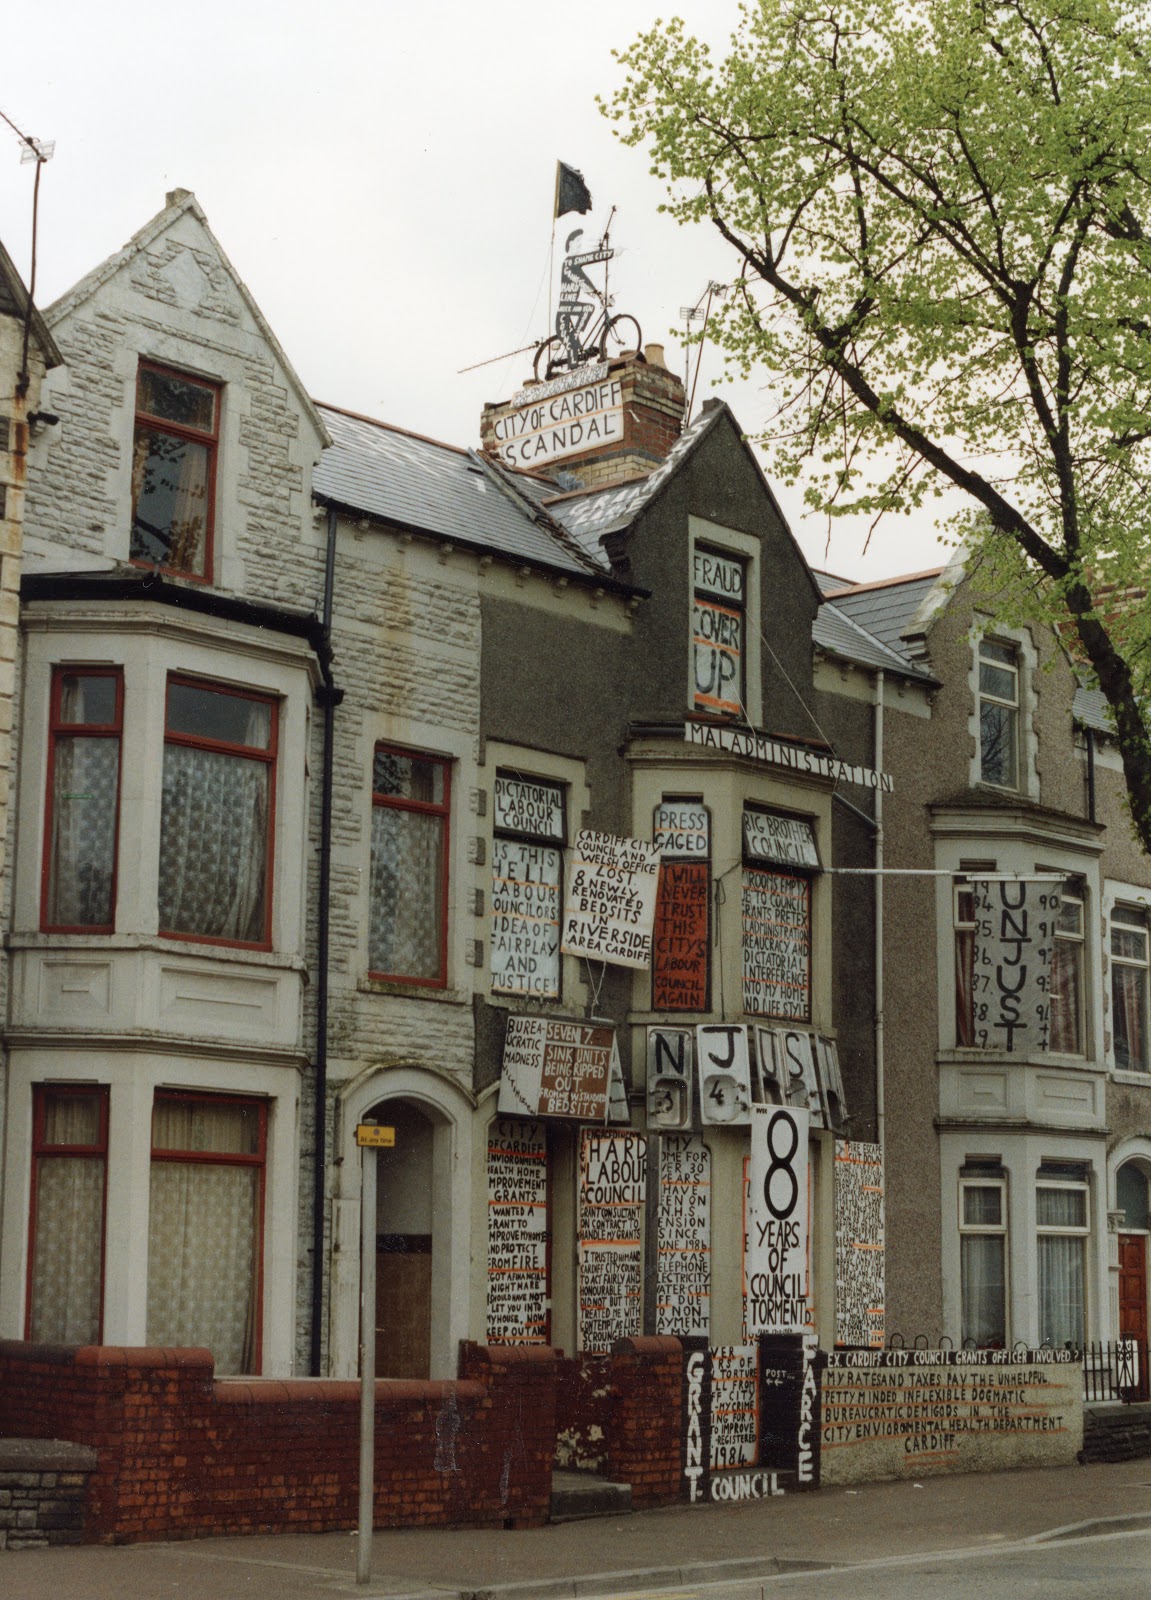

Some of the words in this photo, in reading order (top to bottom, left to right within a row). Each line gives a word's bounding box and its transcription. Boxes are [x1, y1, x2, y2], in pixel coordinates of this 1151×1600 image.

[594, 250, 612, 260] CITY
[560, 282, 579, 292] HARD
[560, 293, 578, 302] LINE
[494, 409, 530, 440] CITY
[530, 406, 546, 430] OF
[550, 380, 620, 422] CARDIFF
[506, 414, 615, 466] SCANDAL
[694, 556, 742, 593] FRAUD
[694, 607, 739, 650] COVER
[694, 644, 736, 698] UP
[691, 724, 893, 793] MALADMINISTRATION
[495, 779, 562, 809] DICTATORIAL
[498, 796, 554, 822] LABOUR
[504, 812, 556, 836] COUNCIL
[660, 811, 706, 830] PRESS
[742, 812, 764, 834] BIG
[766, 816, 814, 844] BROTHER
[580, 830, 627, 848] CARDIFF
[630, 840, 662, 857] CITY
[654, 832, 706, 850] GAGED
[494, 842, 508, 860] IS
[519, 846, 556, 868] THIS
[576, 840, 616, 858] COUNCIL
[620, 850, 646, 862] AND
[580, 851, 618, 868] WELSH
[622, 860, 657, 874] OFFICE
[492, 857, 549, 886] HELL
[492, 880, 556, 904] LABOUR
[574, 870, 584, 886] 8
[589, 878, 638, 899] NEWLY
[661, 884, 706, 900] NEVER
[780, 878, 807, 896] EMPTY
[572, 886, 643, 910] RENOVATED
[752, 890, 766, 904] TO
[770, 892, 806, 912] COUNCIL
[580, 898, 641, 924] BEDSITS
[660, 902, 706, 919] TRUST
[494, 916, 528, 936] IDEA
[532, 923, 550, 938] OF
[592, 915, 608, 926] IN
[660, 918, 697, 935] THIS
[568, 920, 650, 949] RIVERSIDE
[506, 956, 537, 973] AND
[656, 956, 700, 974] LABOUR
[744, 949, 806, 972] DICTATORIAL
[994, 881, 1032, 1051] UNJUST
[656, 976, 704, 990] COUNCIL
[744, 964, 808, 986] INTERFERENCE
[658, 990, 700, 1006] AGAIN
[766, 983, 778, 998] MY
[780, 986, 804, 1002] HOME
[783, 1002, 808, 1018] STYLE
[547, 1023, 578, 1042] SEVEN
[506, 1034, 542, 1051] UCRATIC
[504, 1052, 542, 1068] MADNESS
[546, 1046, 574, 1062] SINK
[544, 1062, 572, 1077] BEING
[573, 1062, 604, 1079] RIPPED
[548, 1098, 597, 1116] BEDSITS
[499, 1123, 537, 1141] CITY
[500, 1140, 544, 1154] CARDIFF
[590, 1138, 646, 1162] HARD
[666, 1136, 692, 1151] MY
[686, 1152, 708, 1162] FOR
[764, 1110, 798, 1220] 8
[864, 1154, 882, 1166] DOWN
[517, 1167, 540, 1178] HOME
[586, 1160, 646, 1184] LABOUR
[690, 1163, 704, 1174] 30
[586, 1186, 646, 1204] COUNCIL
[663, 1185, 698, 1196] HAVE
[689, 1195, 706, 1206] ON
[493, 1206, 524, 1216] WANTED
[516, 1219, 528, 1228] TO
[592, 1220, 627, 1230] CONTRACT
[580, 1230, 605, 1240] HANDLE
[616, 1230, 640, 1240] GRANTS
[658, 1228, 698, 1240] SINCE
[501, 1244, 538, 1254] PROTECT
[658, 1252, 676, 1262] MY
[681, 1252, 705, 1262] GAS
[590, 1252, 618, 1264] TRUSTED
[768, 1248, 789, 1274] OF
[580, 1264, 604, 1274] CARDIFF
[606, 1263, 620, 1274] CITY
[491, 1281, 540, 1294] NIGHTMARE
[604, 1274, 626, 1284] FAIRLY
[626, 1274, 640, 1284] AND
[750, 1273, 806, 1298] COUNCIL
[530, 1293, 546, 1302] NOT
[580, 1285, 622, 1296] HONOURABLE
[624, 1285, 640, 1295] THEY
[688, 1284, 711, 1294] CUT
[492, 1304, 504, 1313] LET
[524, 1302, 542, 1312] INTO
[610, 1297, 622, 1306] BUT
[624, 1296, 640, 1307] THEY
[678, 1295, 702, 1306] DUE
[527, 1313, 545, 1323] NOW
[580, 1308, 610, 1320] TREATED
[613, 1308, 622, 1318] ME
[624, 1307, 640, 1318] WITH
[672, 1306, 701, 1316] NON
[750, 1299, 806, 1326] TORMENT
[580, 1320, 614, 1332] CONTEMPT
[624, 1319, 640, 1329] LIKE
[740, 1357, 752, 1368] OF
[846, 1351, 882, 1368] CARDIFF
[886, 1352, 908, 1366] CITY
[914, 1351, 951, 1365] COUNCIL
[956, 1350, 988, 1364] GRANTS
[992, 1350, 1028, 1364] OFFICER
[720, 1368, 757, 1379] TORTURE
[766, 1368, 787, 1379] POST
[827, 1371, 844, 1386] MY
[909, 1372, 942, 1386] TAXES
[947, 1373, 967, 1386] PAY
[970, 1373, 994, 1386] THE
[732, 1380, 756, 1390] FROM
[729, 1390, 754, 1401] CITY
[825, 1390, 855, 1404] PETTY
[858, 1391, 897, 1404] MINDED
[904, 1388, 966, 1404] INFLEXIBLE
[800, 1334, 817, 1482] FARCE
[906, 1404, 958, 1418] DEMIGODS
[970, 1406, 980, 1417] IN
[990, 1406, 1010, 1418] THE
[722, 1422, 754, 1434] IMPROVE
[824, 1426, 852, 1442] CITY
[949, 1419, 990, 1430] HEALTH
[994, 1416, 1063, 1430] DEPARTMENT
[712, 1472, 784, 1500] COUNCIL
